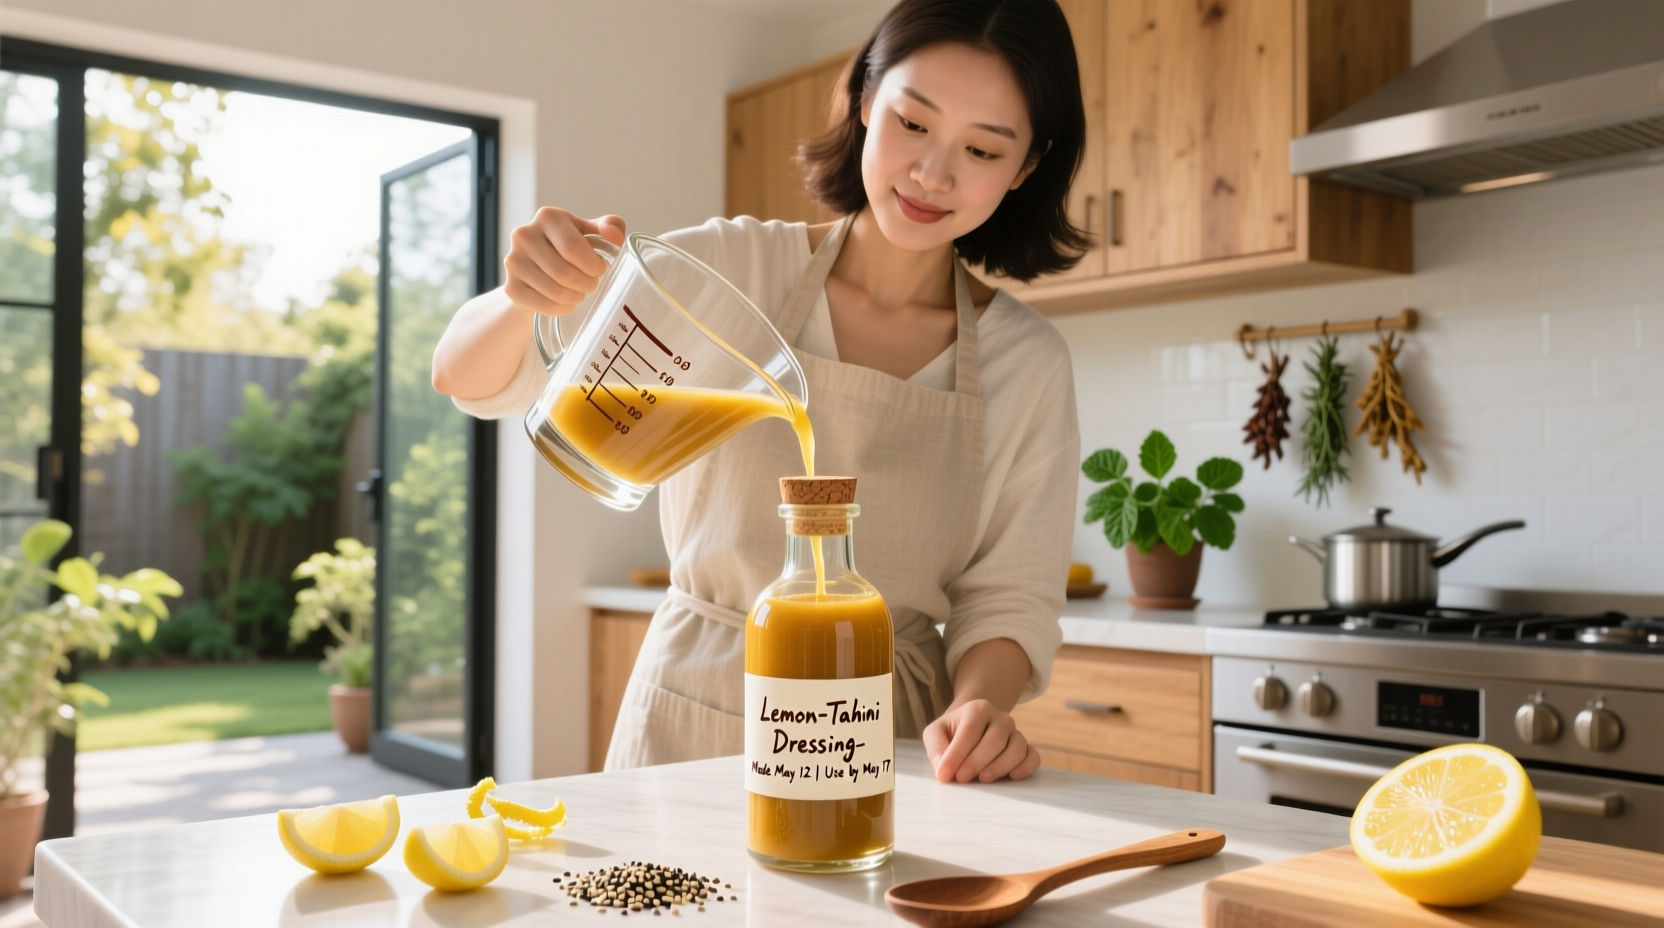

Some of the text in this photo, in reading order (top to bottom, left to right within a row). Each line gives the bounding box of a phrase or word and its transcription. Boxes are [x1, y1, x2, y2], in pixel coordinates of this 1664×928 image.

[760, 696, 880, 725] Lemon-Tahini
[772, 728, 865, 763] Dressing-
[774, 763, 796, 784] May
[799, 765, 812, 779] 12
[825, 764, 845, 779] Use
[848, 763, 859, 783] by
[882, 759, 892, 773] 17
